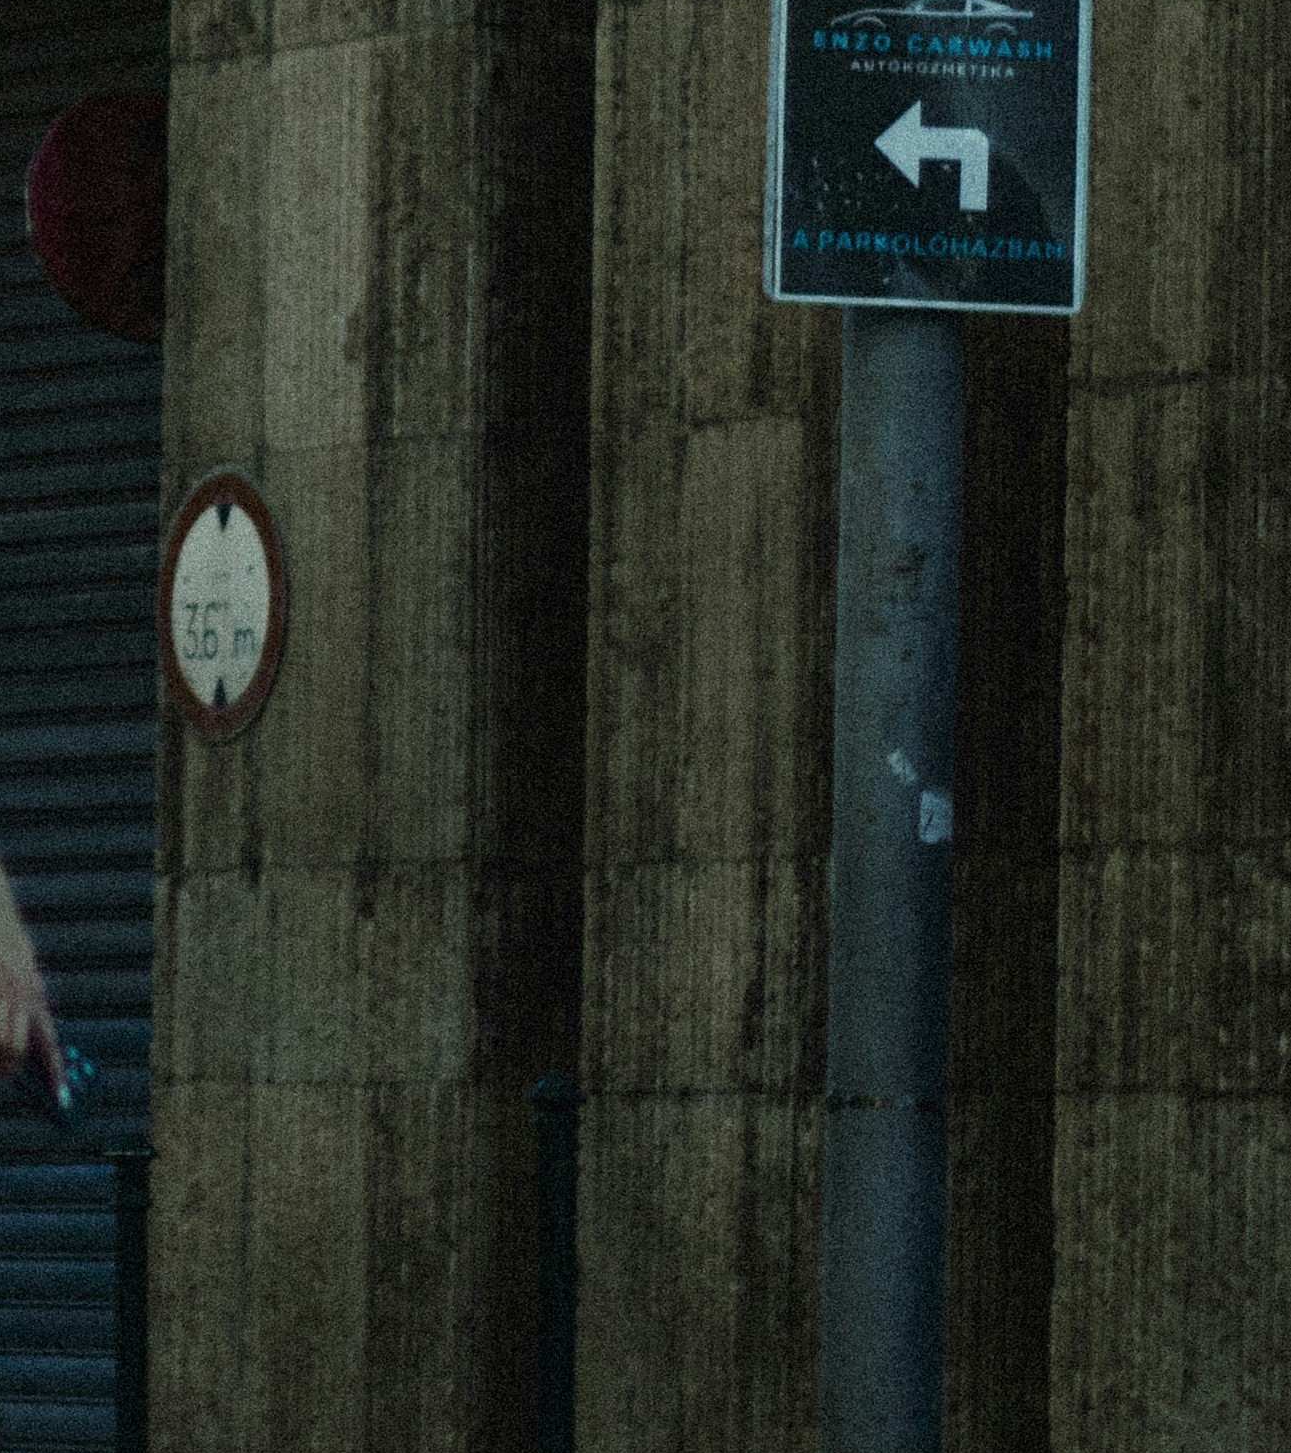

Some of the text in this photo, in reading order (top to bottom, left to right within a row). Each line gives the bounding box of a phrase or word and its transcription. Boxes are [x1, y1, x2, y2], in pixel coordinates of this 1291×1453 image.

[811, 28, 1055, 61] ENZO CARWASH
[790, 227, 810, 251] A
[233, 627, 257, 657] m
